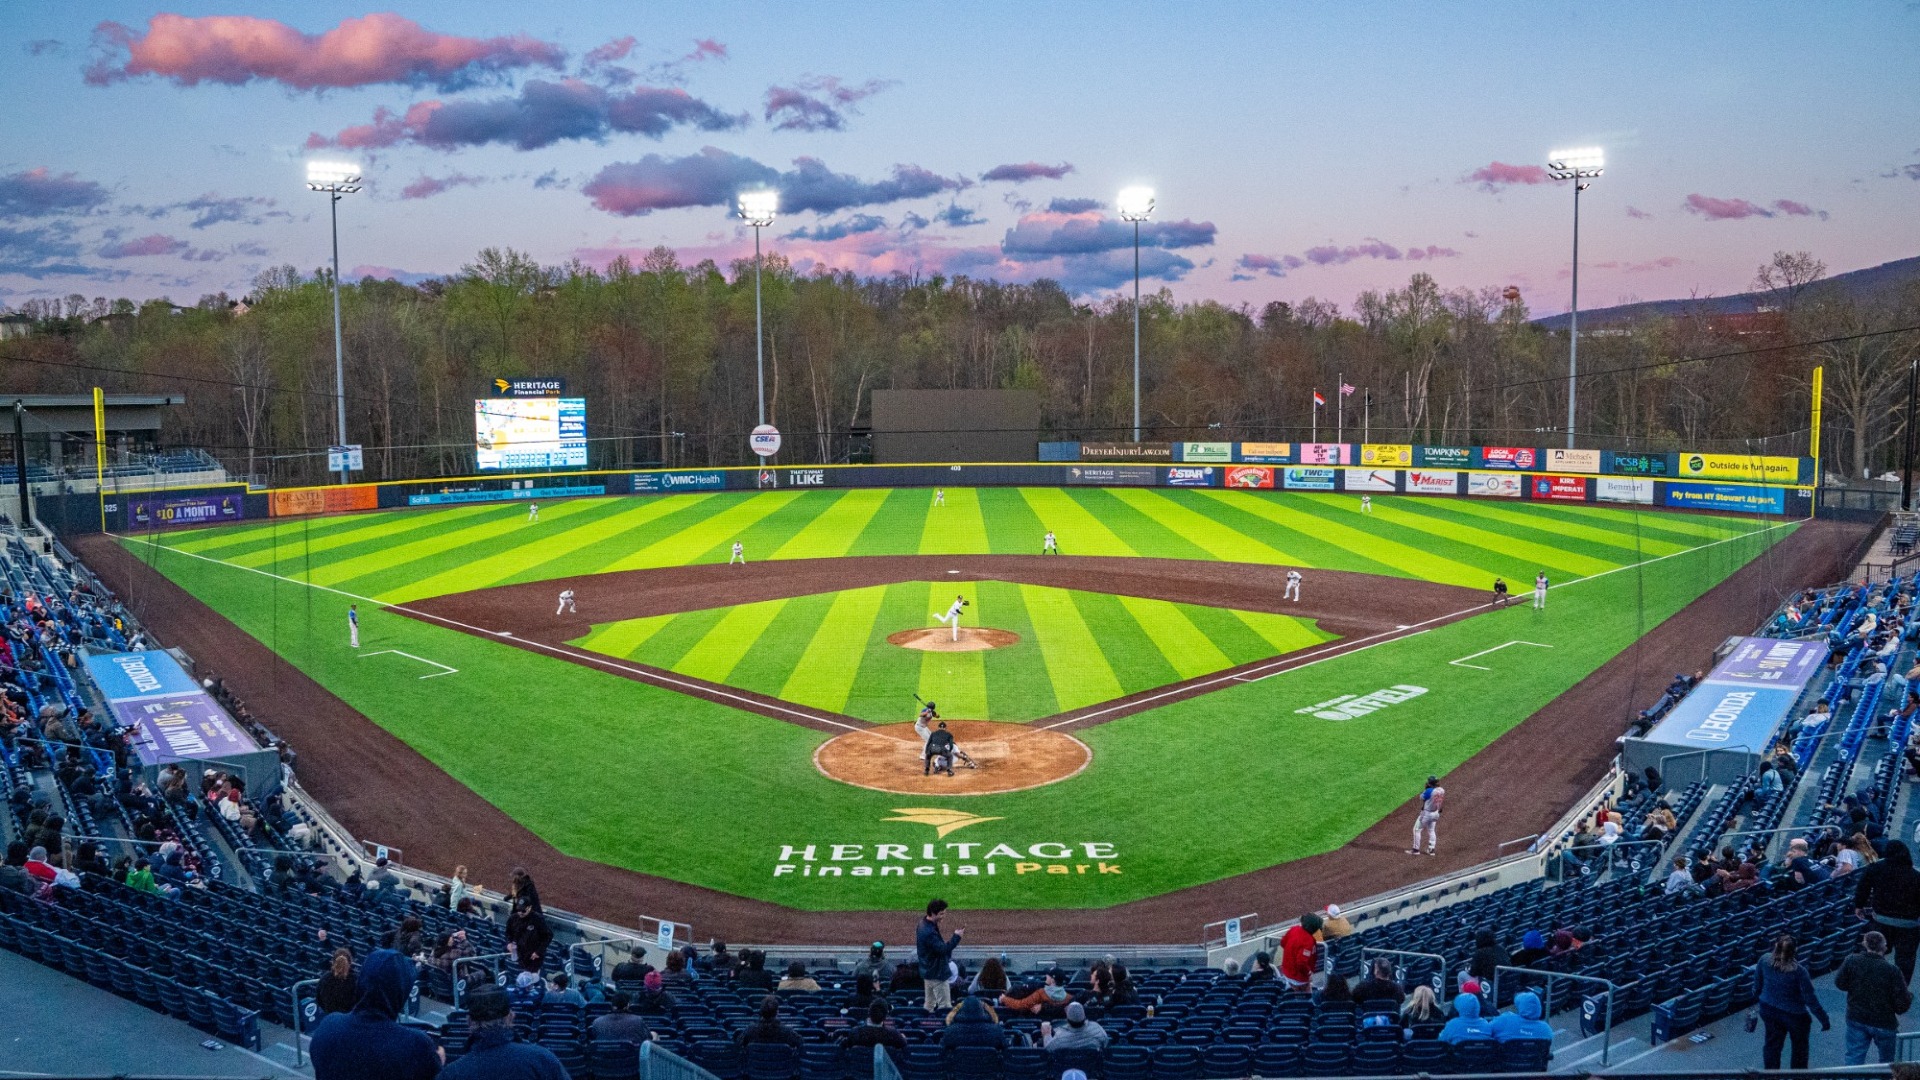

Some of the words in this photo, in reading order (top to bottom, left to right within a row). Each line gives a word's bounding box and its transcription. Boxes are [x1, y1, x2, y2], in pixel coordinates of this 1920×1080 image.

[1424, 448, 1460, 457] TOMPKINS
[1615, 457, 1638, 466] PCSB
[1710, 461, 1740, 470] Outside
[1765, 464, 1790, 473] again.
[797, 475, 824, 485] LIKE
[1421, 476, 1455, 486] MARIST
[1607, 483, 1643, 491] Benmarl
[1672, 491, 1683, 500] Fly
[1685, 491, 1703, 500] from
[1715, 494, 1746, 502] Stewart
[1798, 489, 1812, 497] 325
[156, 508, 175, 520] $10
[176, 507, 183, 519] A
[184, 505, 217, 518] MONTH
[121, 661, 162, 693] HONDA
[1699, 691, 1757, 731] HONDA
[778, 842, 1119, 862] HERITAGE
[773, 863, 996, 878] Financial
[1015, 862, 1123, 876] Park
